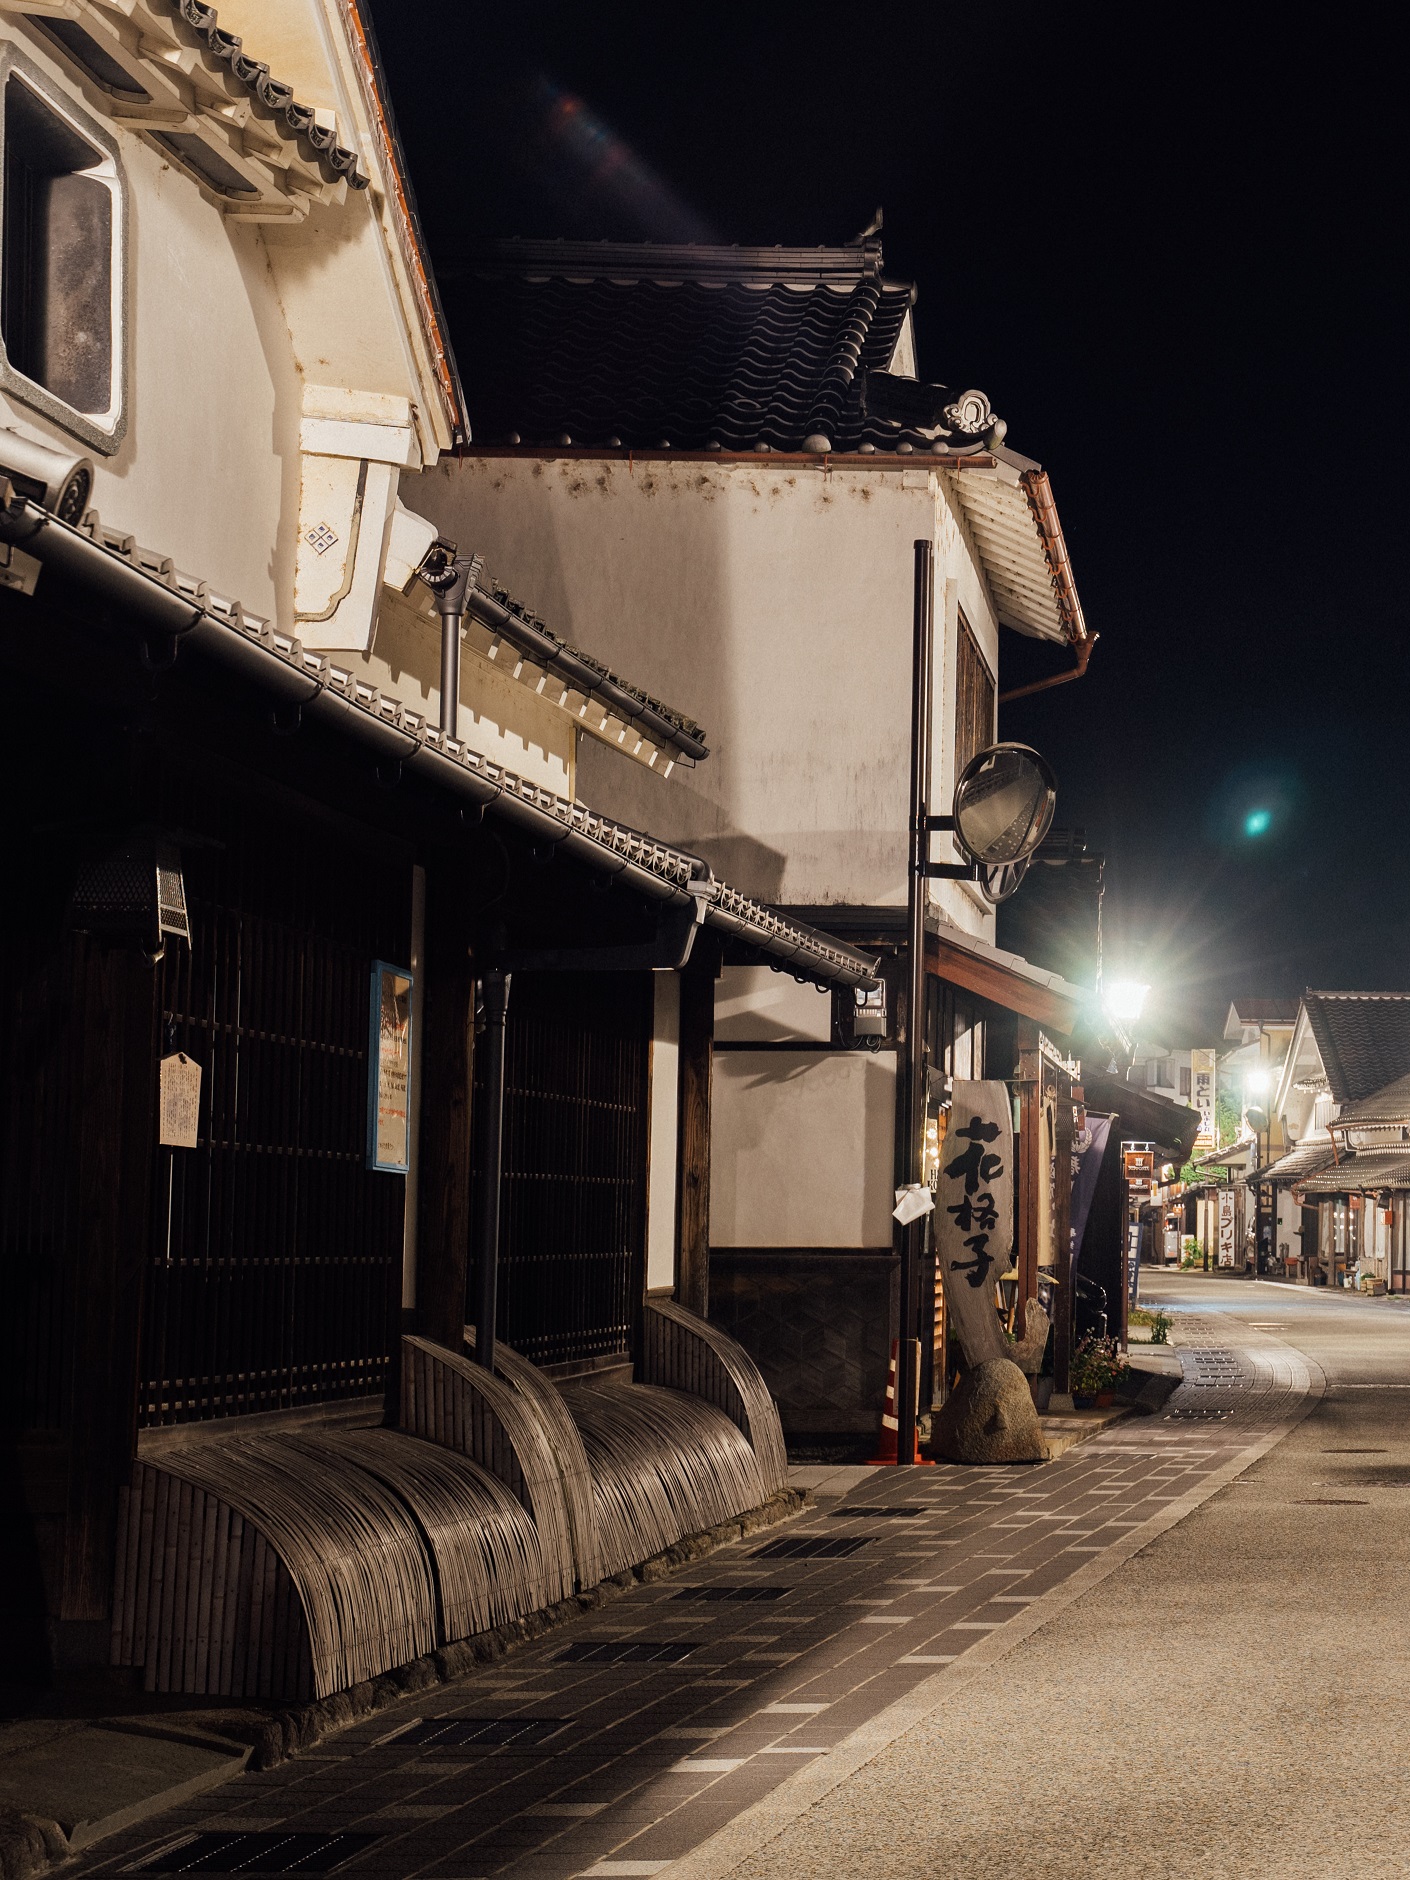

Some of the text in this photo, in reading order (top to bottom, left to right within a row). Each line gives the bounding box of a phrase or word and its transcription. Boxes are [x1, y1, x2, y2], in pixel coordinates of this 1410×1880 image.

[1196, 1073, 1211, 1108] 雨とい
[943, 1116, 1004, 1288] 花格子
[1220, 1193, 1234, 1266] 小島ブリキ店
